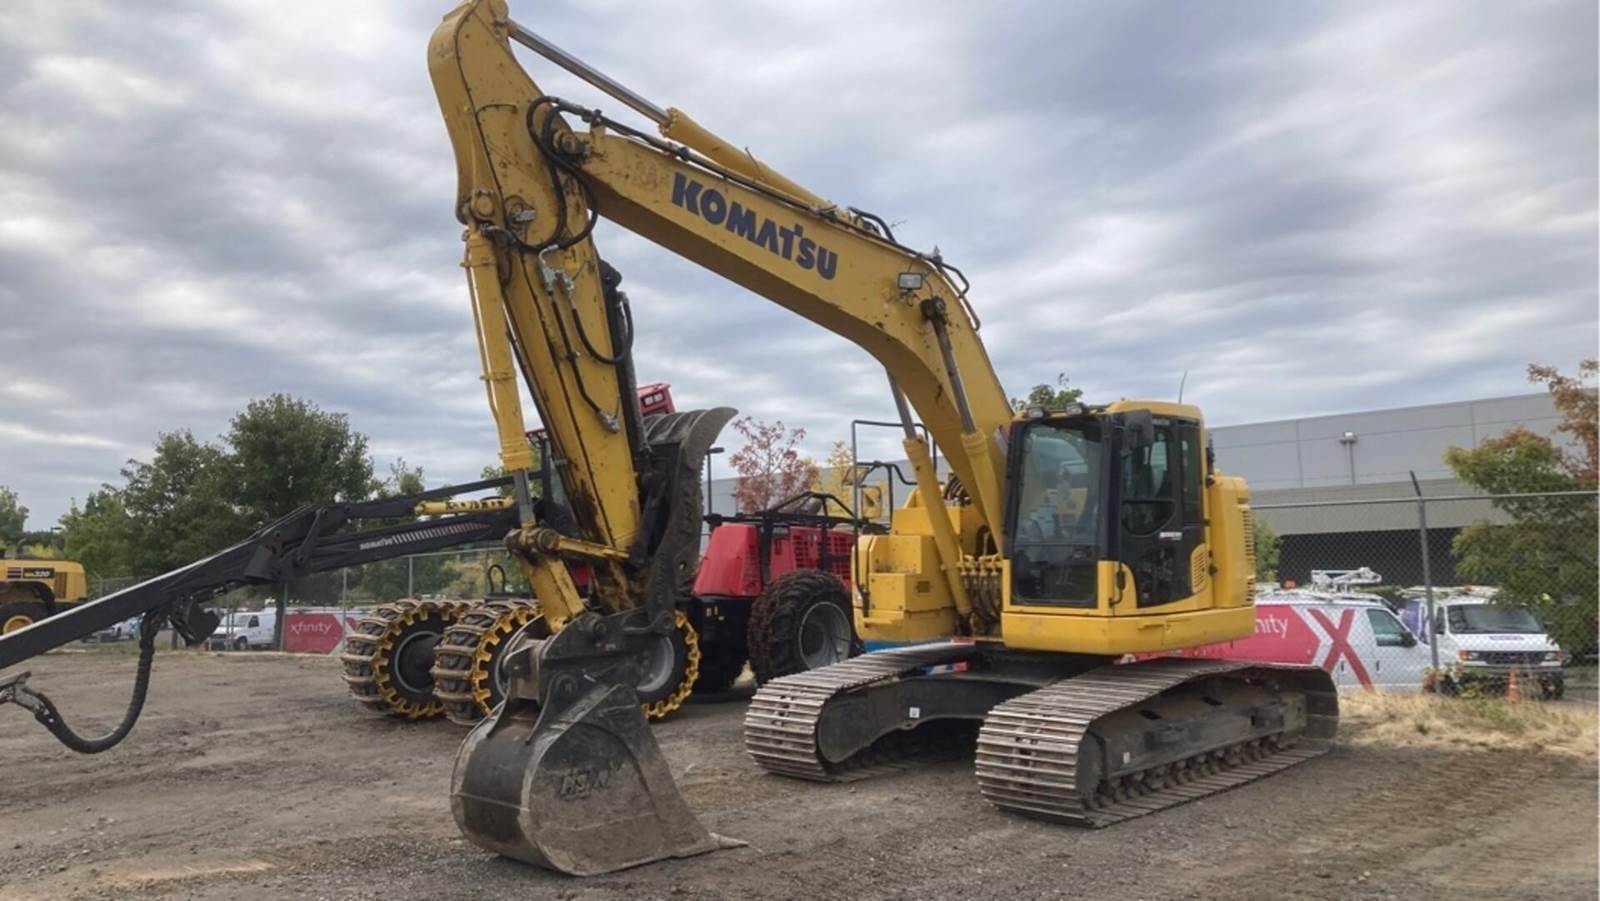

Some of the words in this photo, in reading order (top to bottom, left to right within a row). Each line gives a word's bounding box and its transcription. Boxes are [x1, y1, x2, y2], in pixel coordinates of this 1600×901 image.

[672, 171, 838, 280] KOMATSU
[290, 621, 332, 635] xfinity
[1254, 614, 1288, 638] nity
